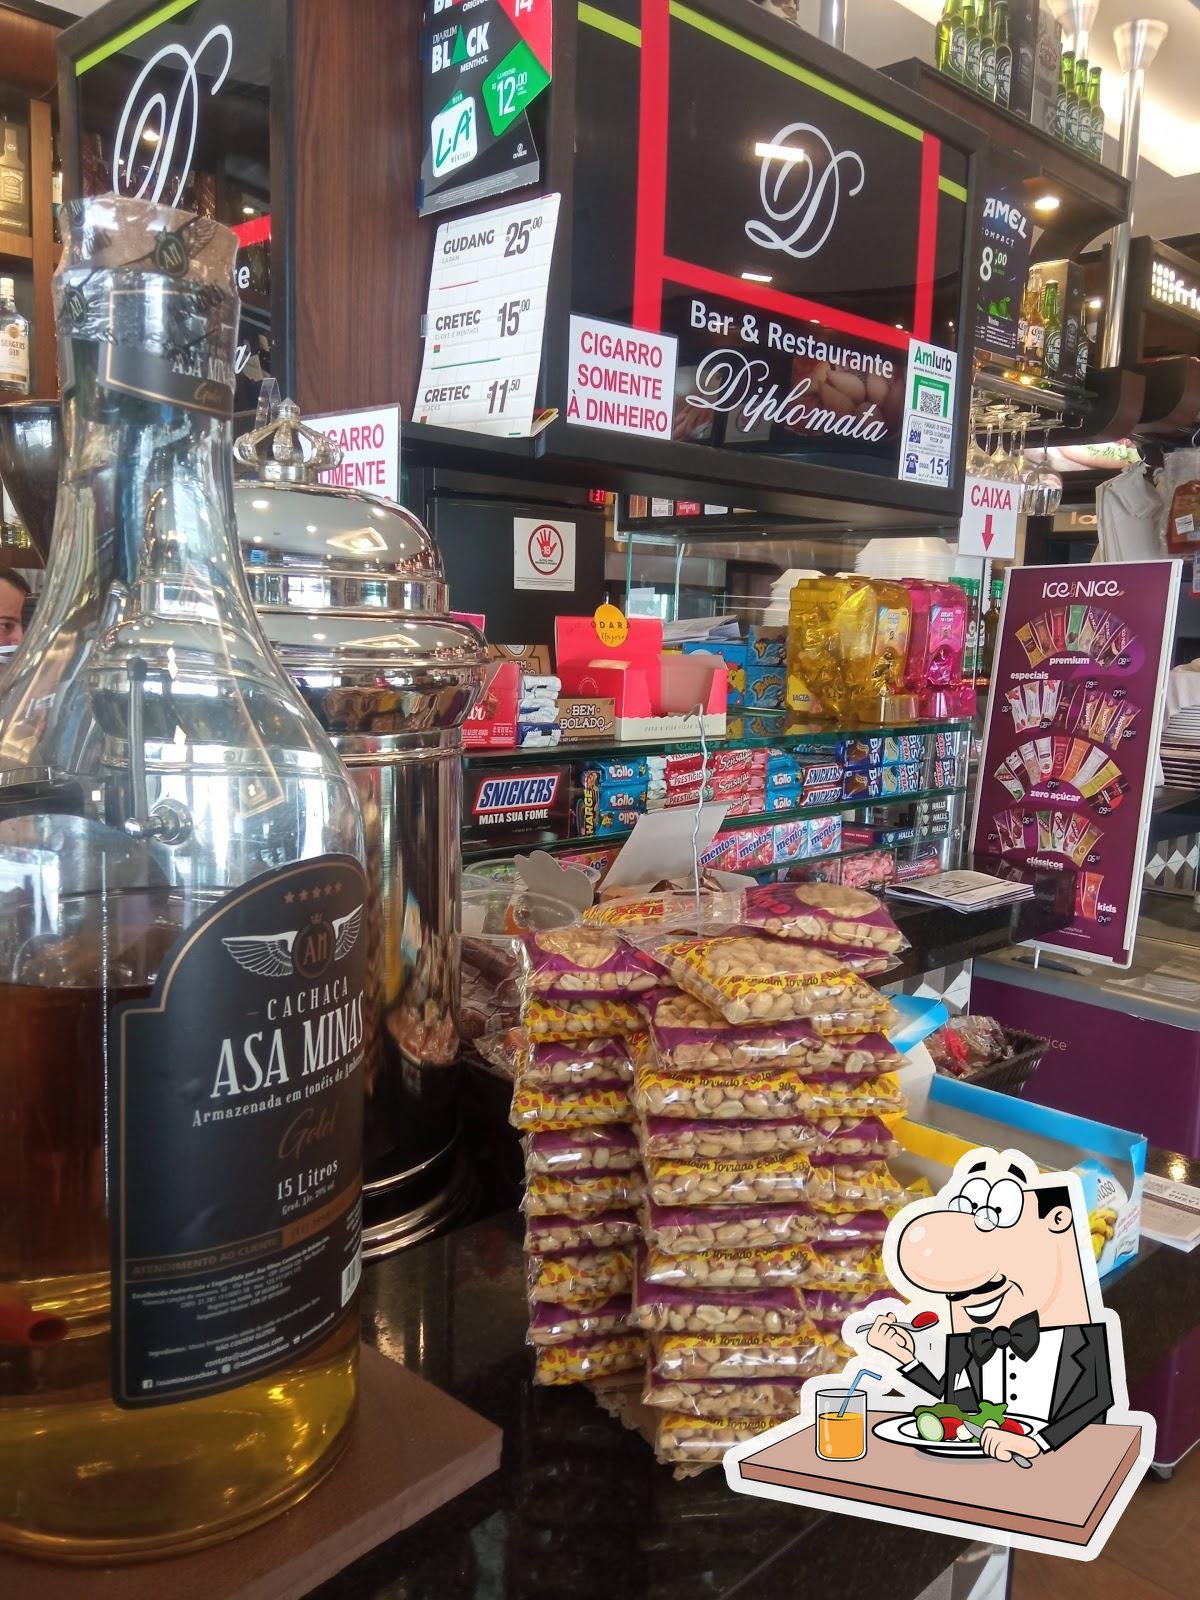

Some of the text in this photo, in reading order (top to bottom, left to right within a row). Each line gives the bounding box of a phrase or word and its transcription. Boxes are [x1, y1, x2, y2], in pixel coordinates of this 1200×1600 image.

[460, 55, 489, 73] MENTHOL
[443, 229, 496, 256] GUDANG
[435, 309, 482, 332] CRETEC
[580, 330, 663, 369] CIGARRO
[690, 299, 894, 380] Bar & Restaurante
[424, 384, 471, 404] CRETEC
[577, 363, 663, 401] SOMENTE
[685, 348, 890, 443] Diplomata
[567, 389, 669, 433] À DINHEIRO
[323, 423, 385, 452] GARRO
[319, 460, 386, 487] OMENTE
[970, 483, 1013, 511] CAIXA
[1049, 656, 1090, 666] premium
[1010, 670, 1049, 680] especiais
[559, 716, 606, 731] BOLADO
[571, 705, 596, 716] BEM
[808, 767, 844, 785] SNICKERS
[478, 778, 556, 808] SNICKERS
[931, 801, 946, 812] HALLS
[1030, 789, 1081, 802] zero açúcar
[479, 809, 549, 825] MATA SUA FOME
[583, 788, 594, 836] HARGE
[932, 812, 948, 822] HALLS
[776, 823, 808, 853] mentos
[810, 818, 842, 846] mentos
[898, 830, 914, 841] HALLS
[931, 824, 947, 833] HALLS
[700, 836, 736, 867] mentos
[739, 829, 773, 859] mentos
[1026, 856, 1064, 870] clássicos
[1097, 902, 1117, 914] kids
[267, 976, 348, 1021] CACHAÇA
[210, 990, 364, 1098] ASA MINAS
[192, 1068, 343, 1127] Armazenada em tonéis de
[779, 1081, 797, 1092] 90g
[277, 1159, 339, 1200] 15 Litros
[132, 1237, 279, 1275] ATENDIMENTO AO CLIENTE
[790, 1250, 808, 1261] 90g
